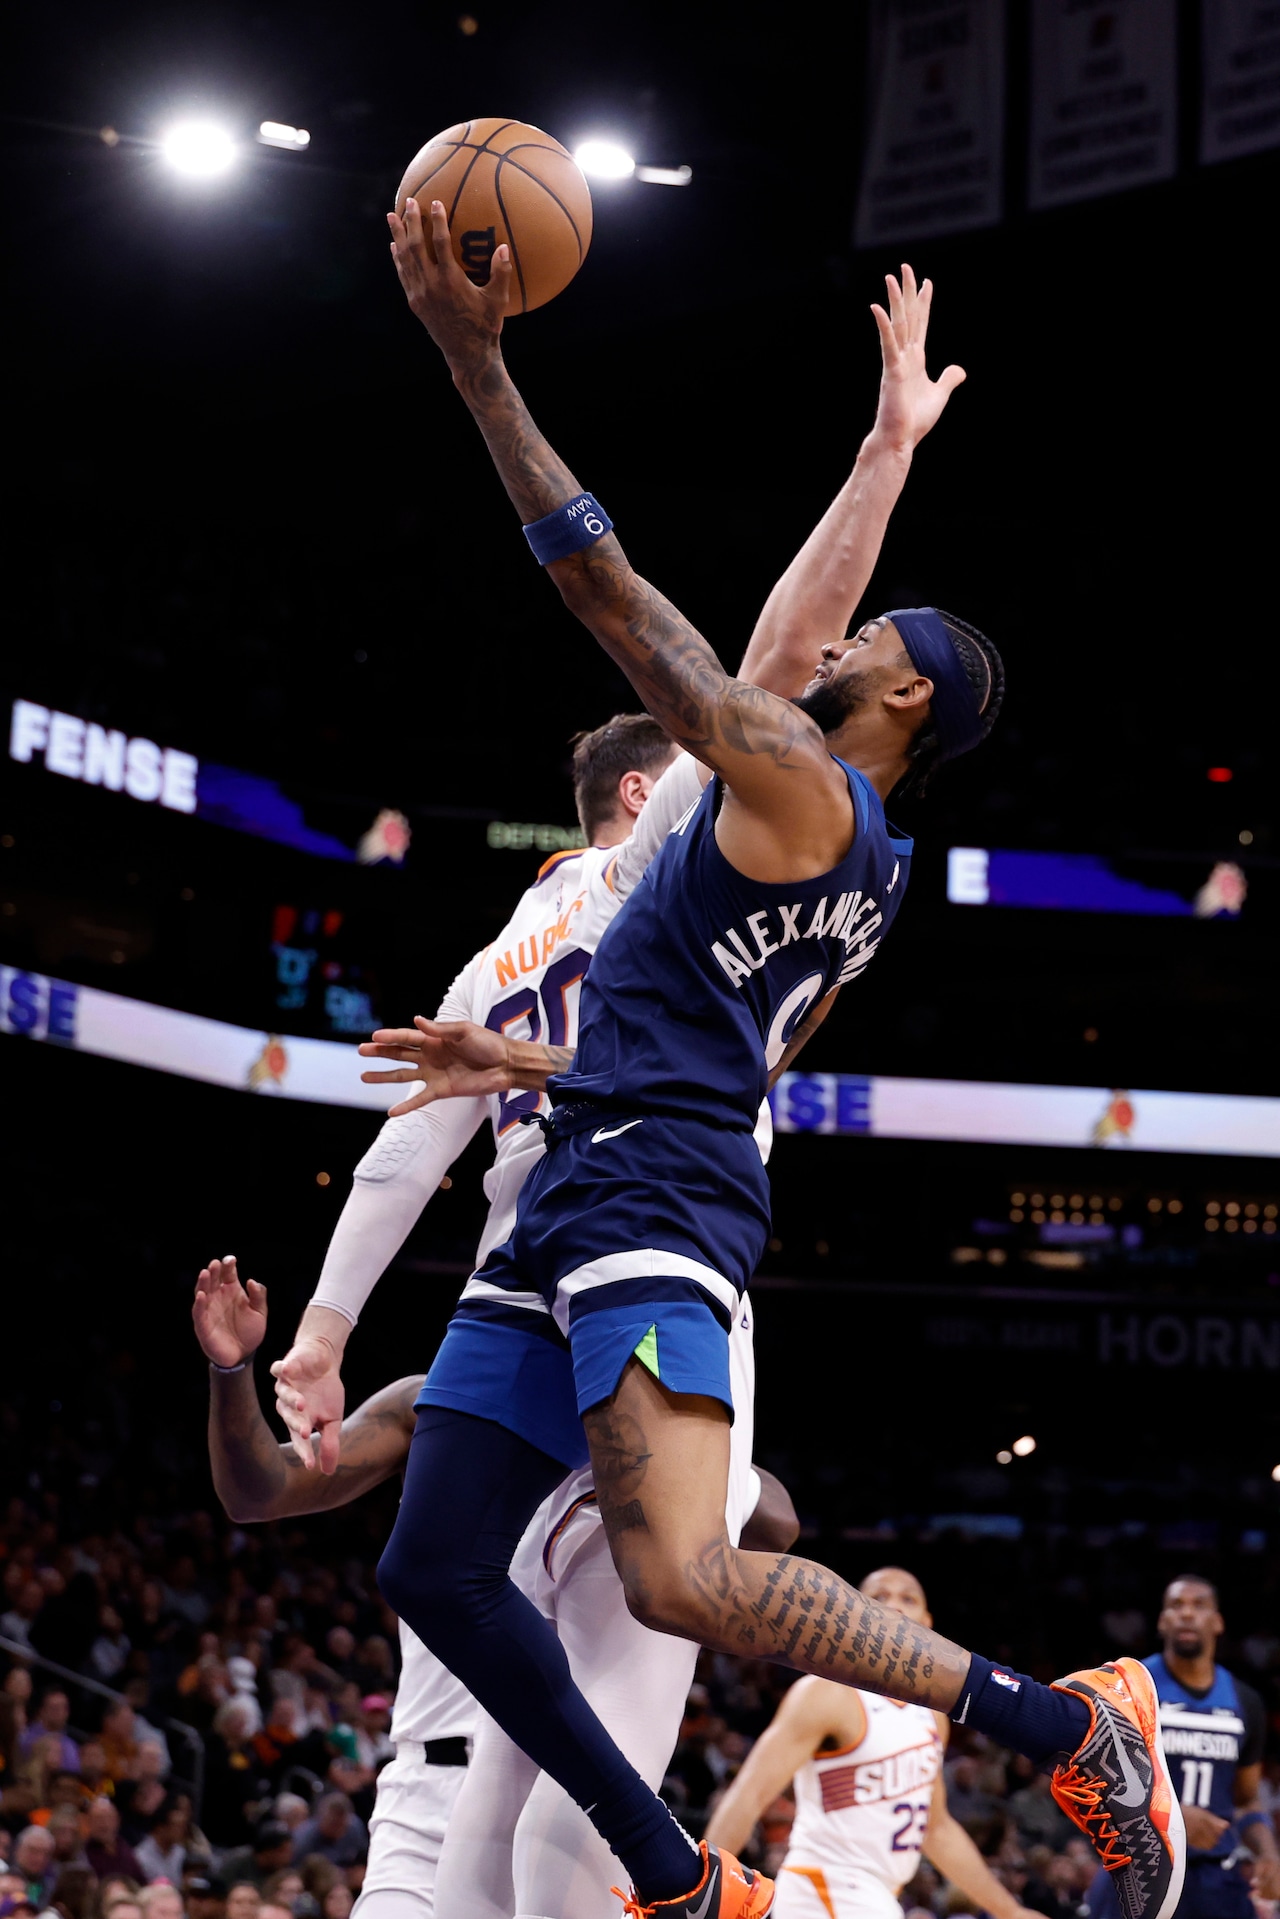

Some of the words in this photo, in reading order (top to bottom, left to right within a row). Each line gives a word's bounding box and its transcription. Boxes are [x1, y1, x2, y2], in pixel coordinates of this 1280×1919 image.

[566, 498, 593, 521] NAW
[10, 698, 199, 815] FENSE
[947, 847, 989, 904] E
[766, 1075, 871, 1131] SE
[854, 1742, 941, 1803] SUNS
[1181, 1760, 1213, 1807] 11
